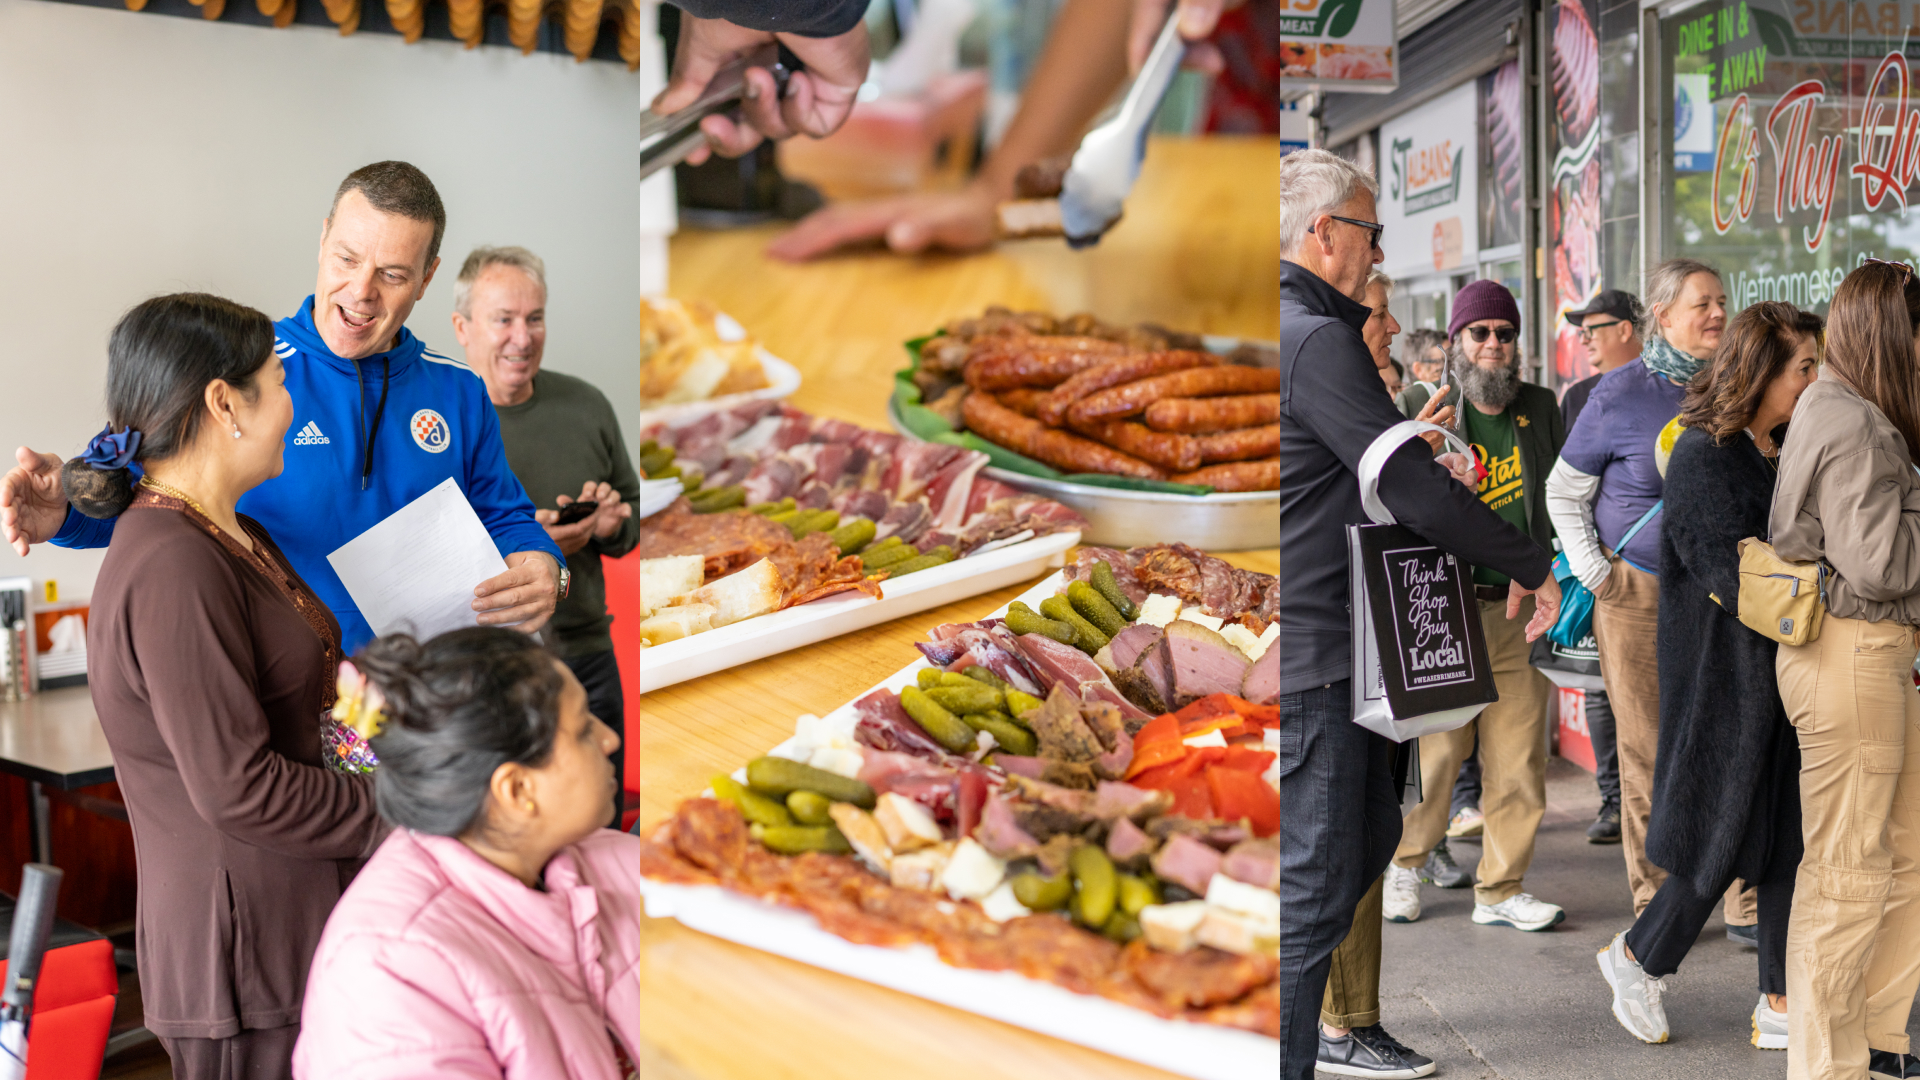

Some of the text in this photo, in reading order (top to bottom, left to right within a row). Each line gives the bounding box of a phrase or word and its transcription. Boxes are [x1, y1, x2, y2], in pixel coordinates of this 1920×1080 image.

[1280, 19, 1317, 33] MEAT
[1679, 13, 1714, 59] DINE
[1718, 5, 1734, 46] IN
[1720, 44, 1767, 96] AWAY
[1406, 139, 1451, 191] ALBANS
[1765, 79, 1843, 253] Thy
[1729, 266, 1845, 313] Vietnamese
[293, 435, 330, 446] adidas
[1398, 556, 1448, 588] Think.
[1408, 584, 1449, 623] Shop.
[1413, 611, 1453, 651] Buy
[1409, 641, 1465, 671] Local
